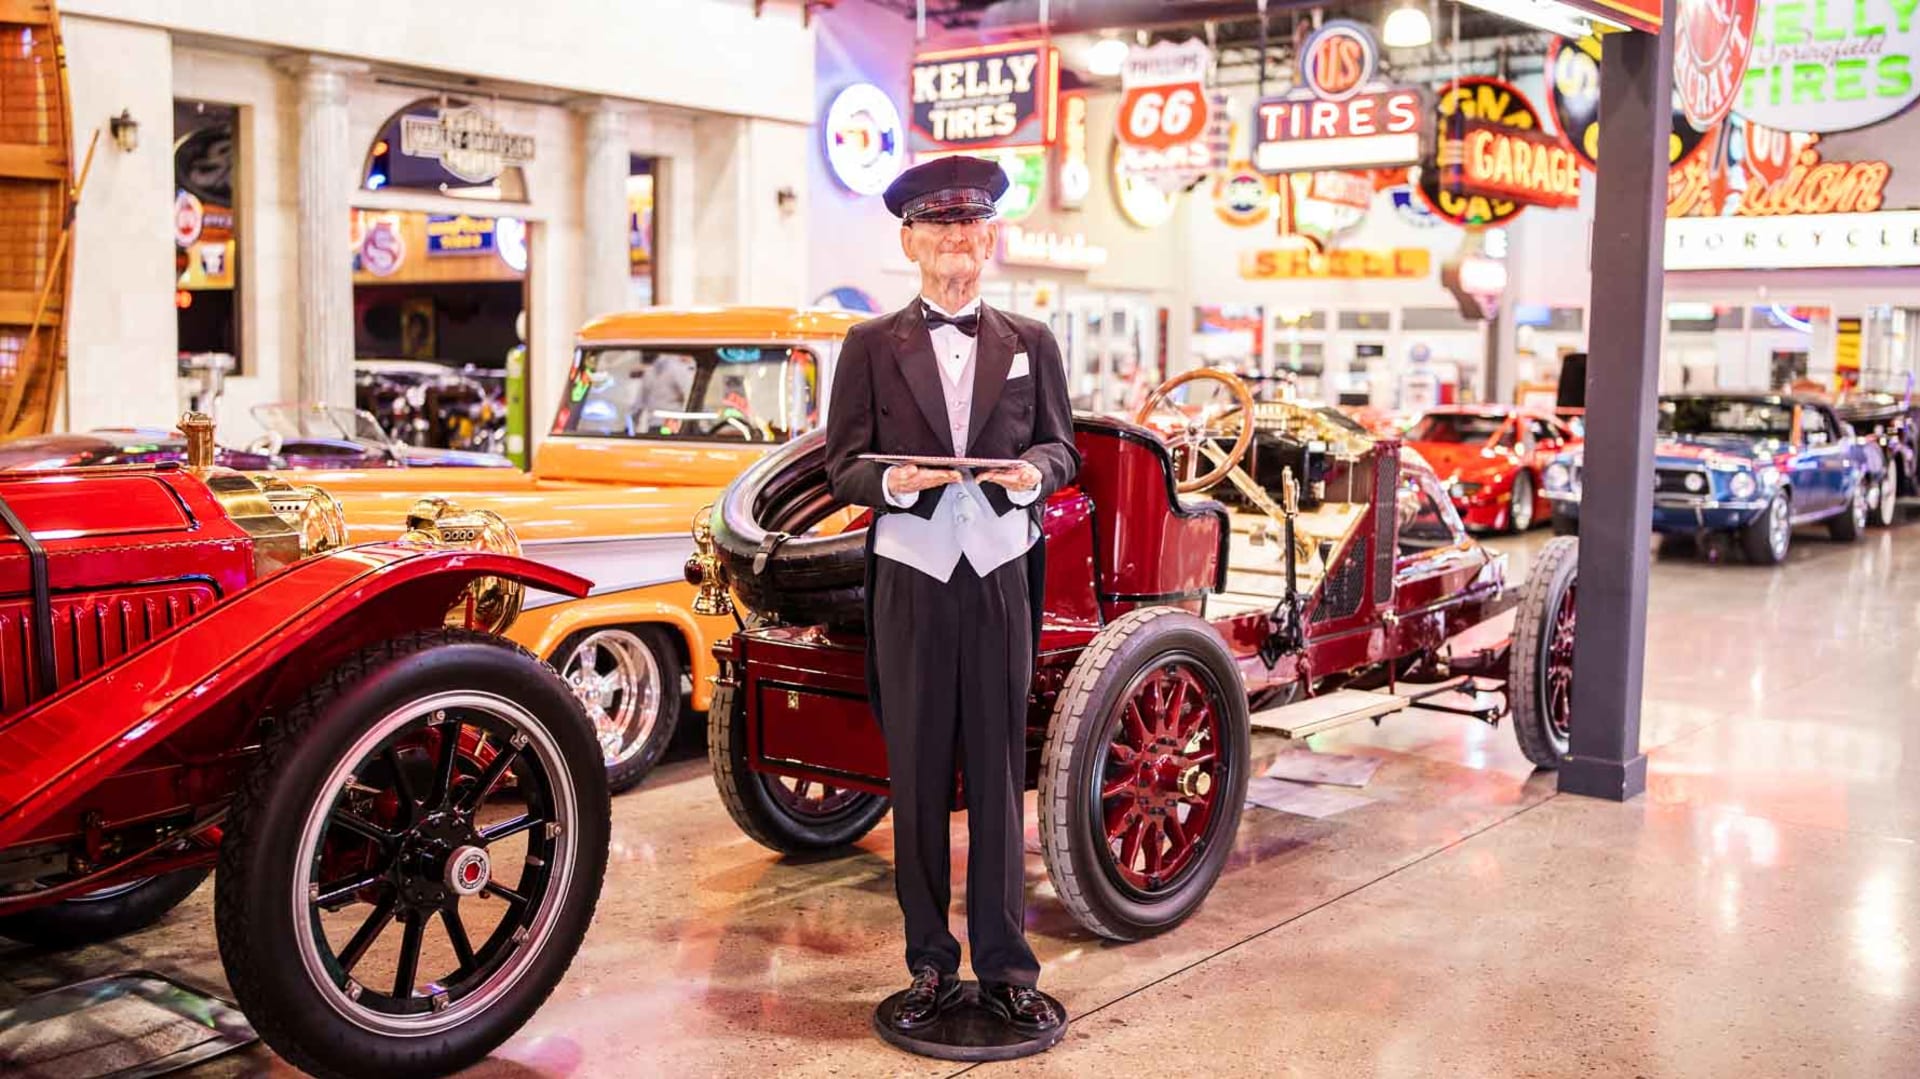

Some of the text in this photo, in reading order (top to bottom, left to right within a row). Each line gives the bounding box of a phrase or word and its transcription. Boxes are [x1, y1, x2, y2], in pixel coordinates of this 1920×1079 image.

[1754, 0, 1919, 46] ELLY
[912, 54, 1038, 103] KELLY
[1316, 35, 1362, 90] US
[1743, 54, 1912, 107] TIRES
[928, 102, 1018, 141] TIRES
[1129, 88, 1196, 138] 66
[1260, 95, 1416, 140] TIRES
[1473, 129, 1581, 197] GARAGE
